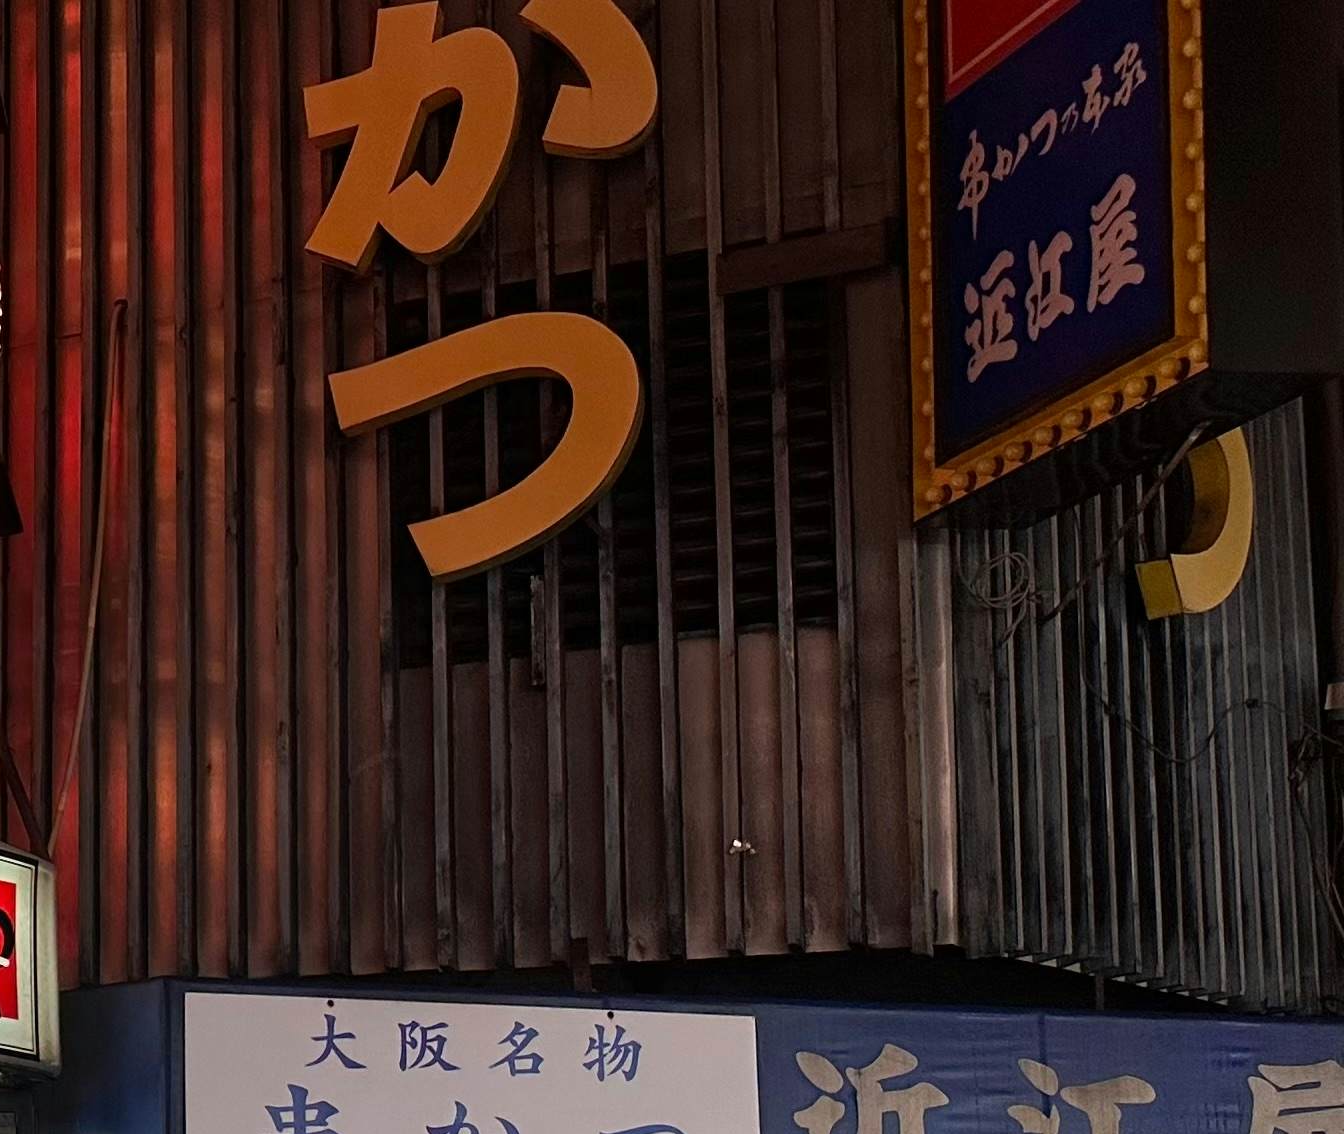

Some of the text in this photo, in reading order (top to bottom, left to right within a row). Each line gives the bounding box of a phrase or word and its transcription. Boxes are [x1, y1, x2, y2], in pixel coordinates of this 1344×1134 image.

[964, 174, 1145, 383] 近江屋
[310, 1014, 643, 1084] 大阪名物
